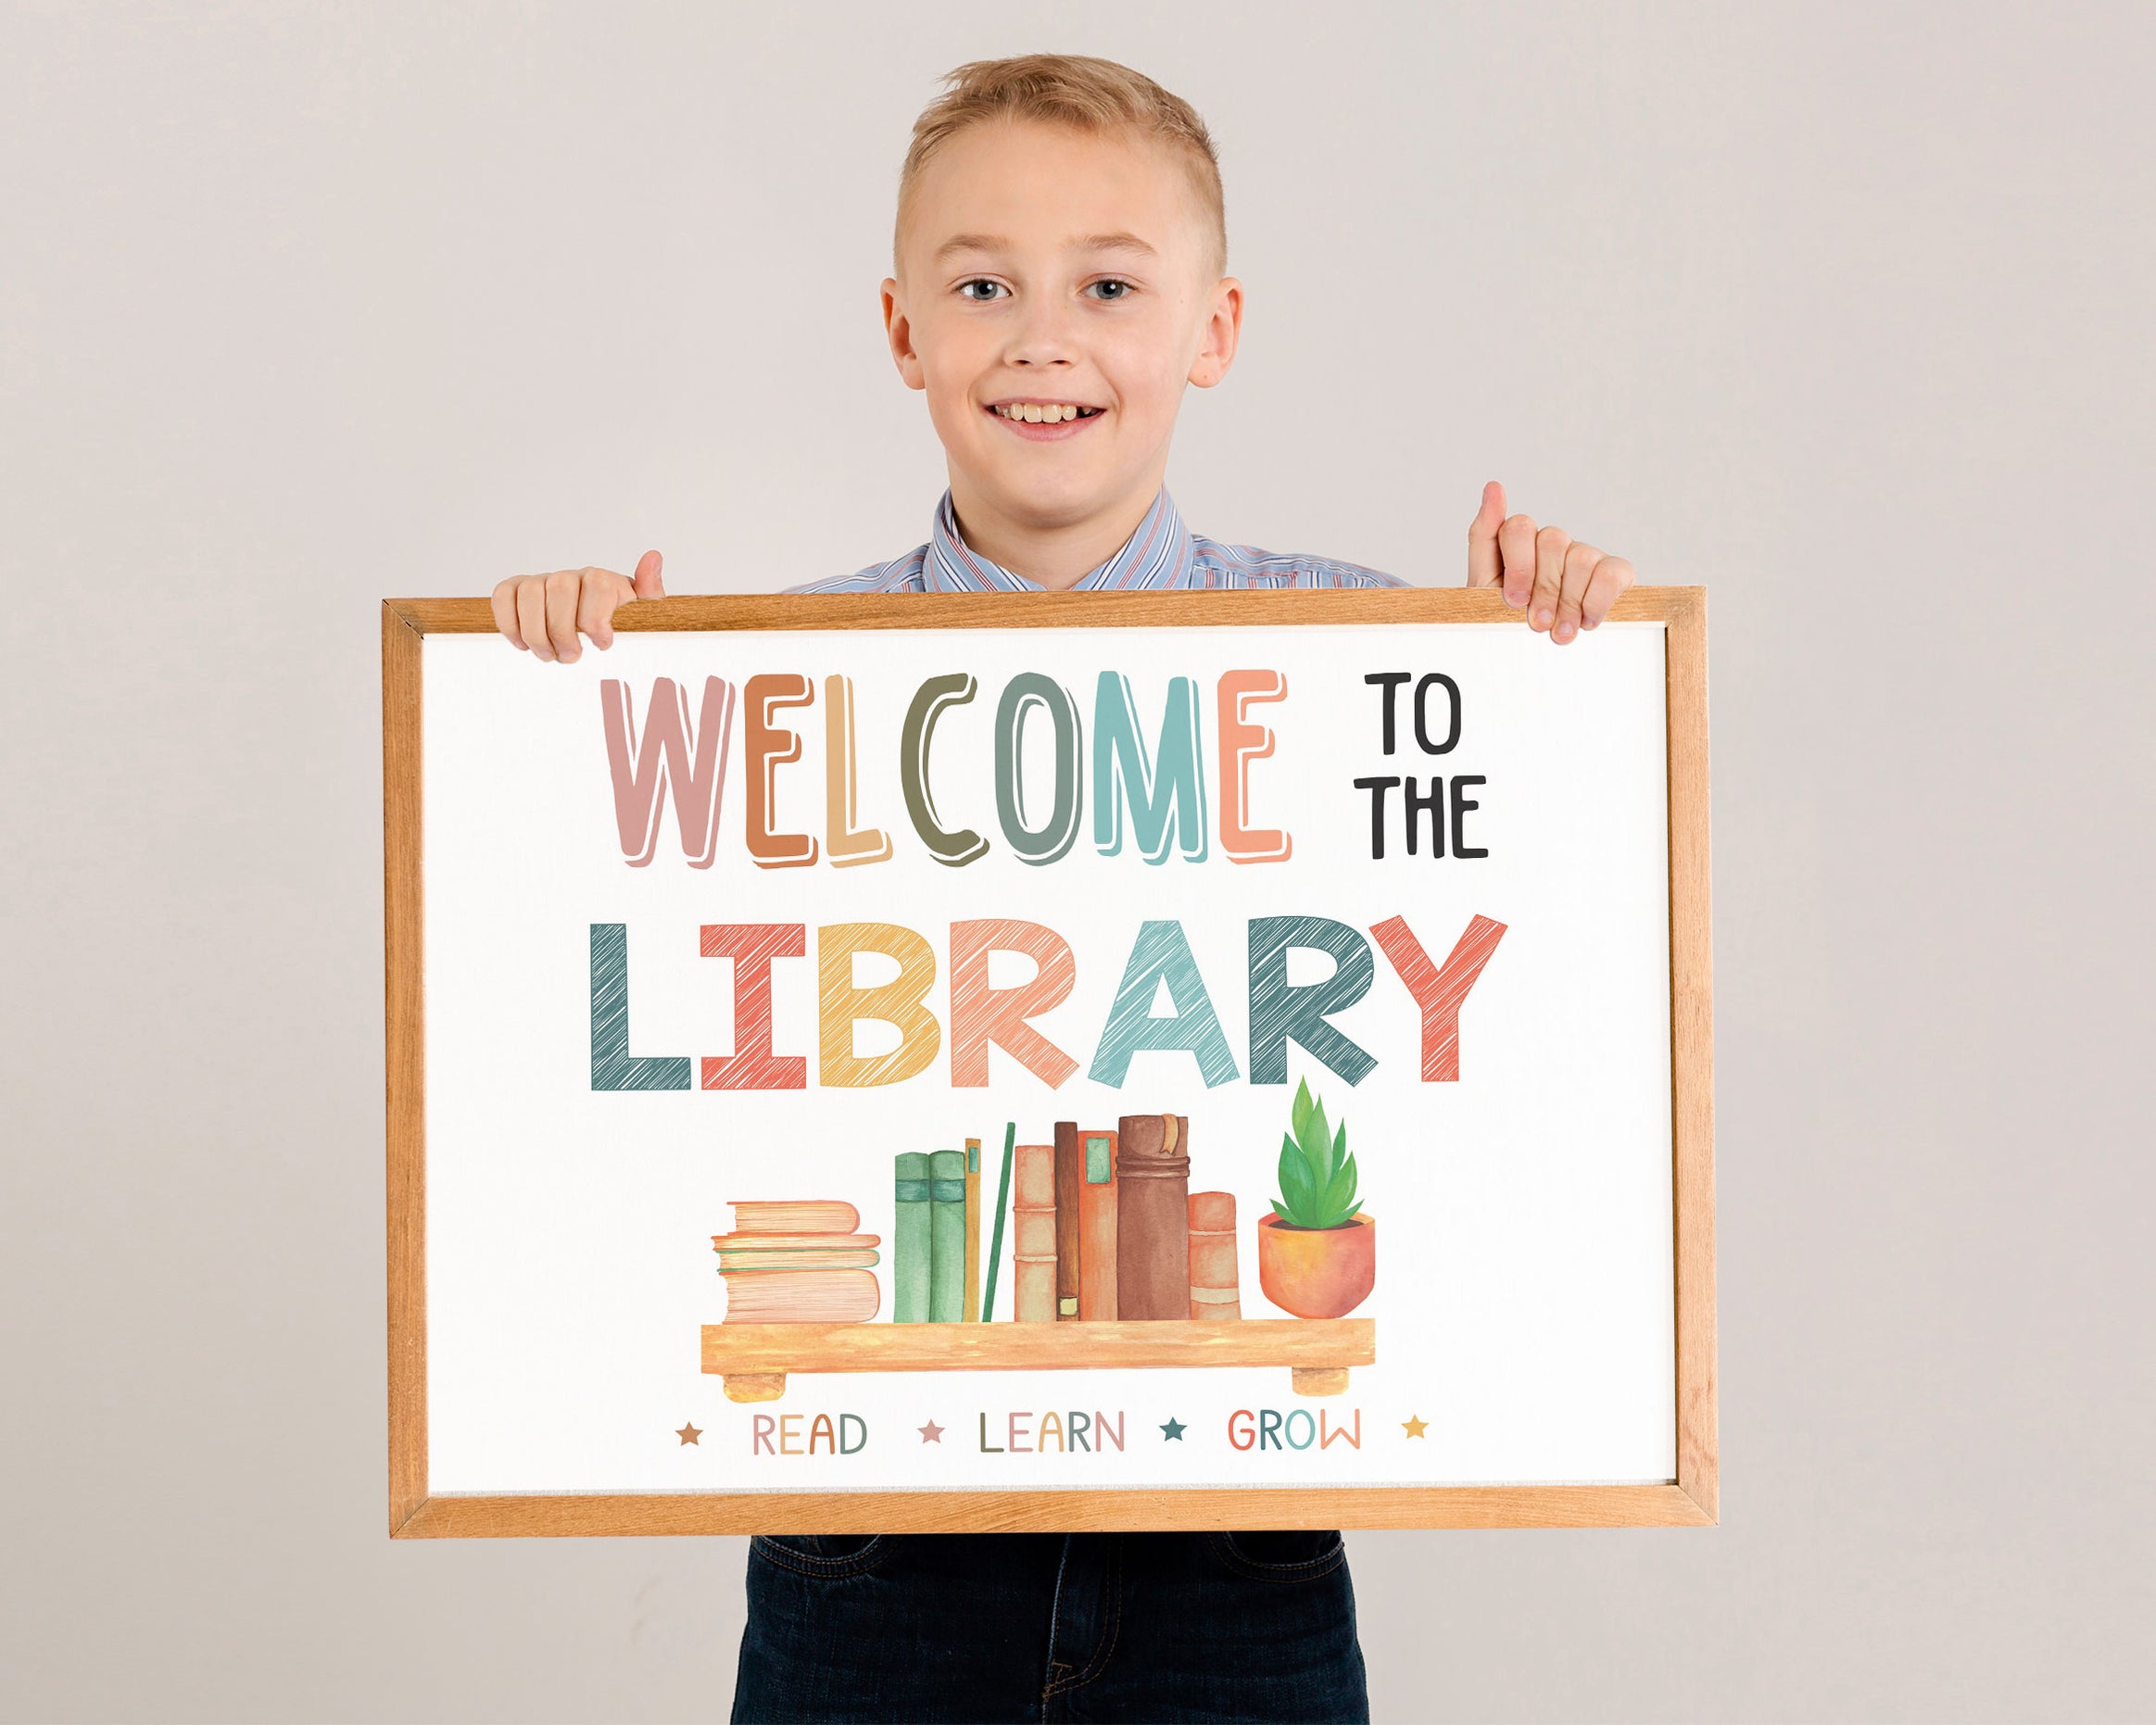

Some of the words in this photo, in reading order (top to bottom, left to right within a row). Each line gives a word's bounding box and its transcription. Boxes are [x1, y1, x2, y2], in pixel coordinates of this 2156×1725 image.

[1364, 672, 1461, 755] TO
[600, 669, 1292, 870] WELCOME
[1354, 775, 1489, 860] THE
[590, 914, 1508, 1091] LIBRARY
[753, 1414, 867, 1455] READ
[980, 1411, 1124, 1453] LEARN
[1228, 1408, 1360, 1451] GROW
